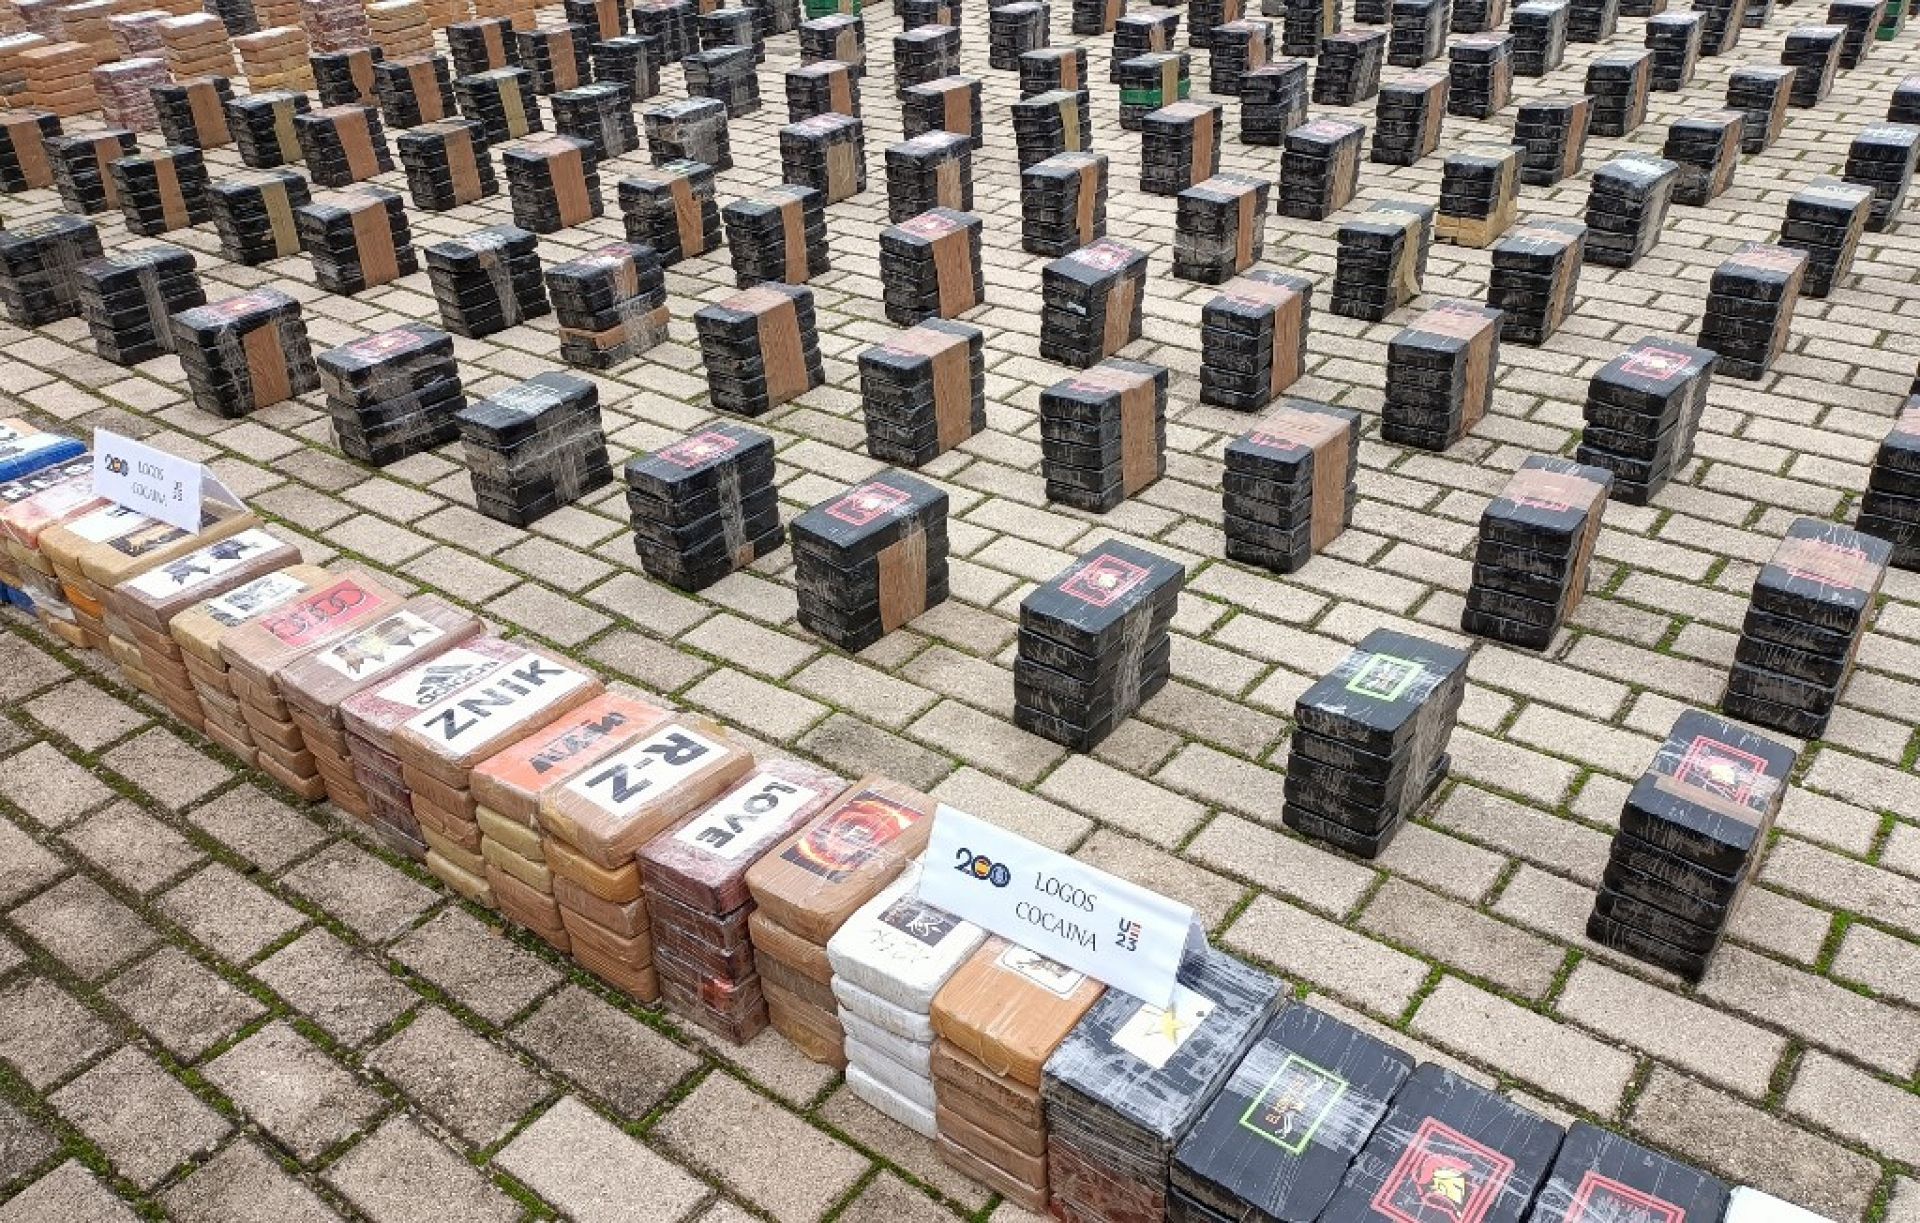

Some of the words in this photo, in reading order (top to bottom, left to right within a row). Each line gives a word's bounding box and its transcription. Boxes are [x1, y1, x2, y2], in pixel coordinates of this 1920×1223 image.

[423, 660, 567, 741] ZNIK
[585, 733, 710, 803] R-Z
[695, 782, 797, 848] LOVE
[1035, 872, 1097, 912] LOGOS
[1016, 902, 1096, 951] COCAINA
[1115, 932, 1138, 951] 23
